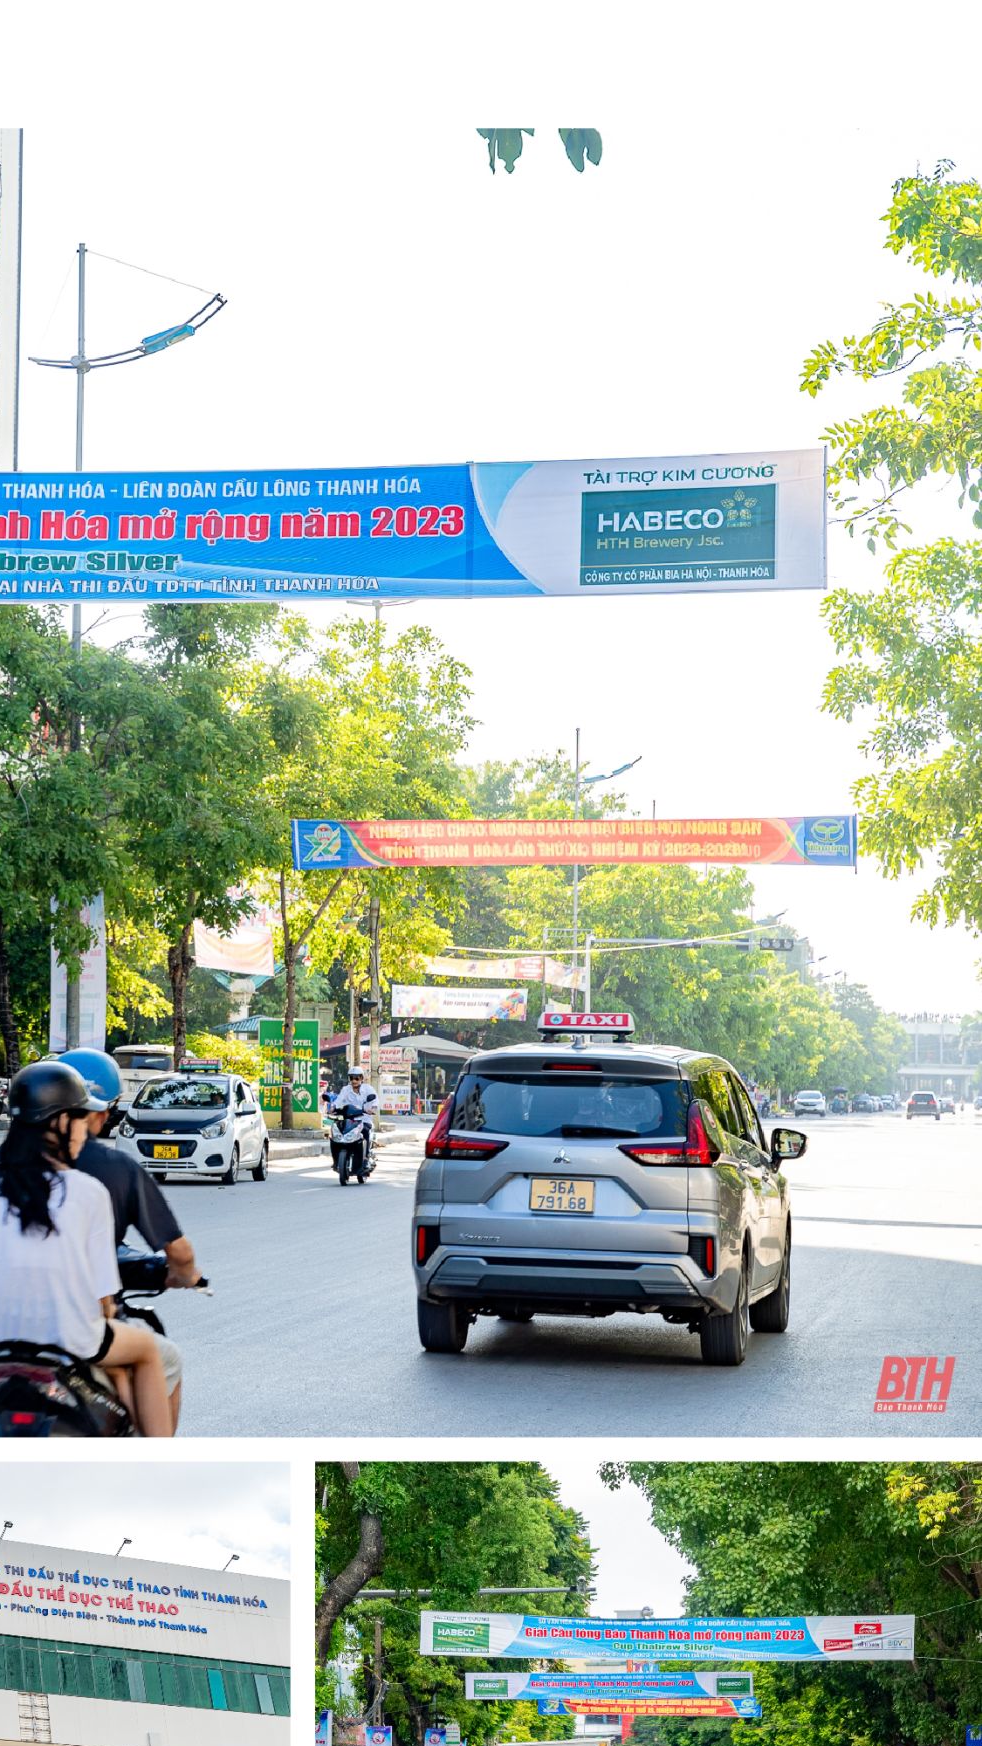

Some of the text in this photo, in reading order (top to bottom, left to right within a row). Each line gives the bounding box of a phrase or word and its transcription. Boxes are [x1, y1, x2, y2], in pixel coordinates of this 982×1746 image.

[2, 482, 65, 500] THANH
[68, 479, 105, 500] HÓA
[123, 480, 163, 499] LIÊN
[167, 478, 217, 499] ĐOÀN
[222, 476, 259, 498] CẦU
[263, 477, 311, 498] LÔNG
[315, 479, 379, 497] THANH
[384, 478, 422, 495] HÓA
[40, 509, 109, 541] Hóa
[119, 508, 177, 540] mở
[185, 509, 272, 546] rộng
[279, 507, 363, 539] năm
[370, 504, 465, 538] 2023
[598, 508, 724, 533] HABECO
[84, 552, 180, 573] Silver
[23, 576, 65, 594] NHÀ
[68, 578, 103, 594] THI
[107, 575, 147, 594] ĐẤU
[153, 578, 206, 594] TDTT
[209, 573, 257, 593] TỈNH
[262, 578, 333, 593] THANH
[337, 575, 380, 592] HÓA
[567, 1015, 623, 1026] TAXI
[549, 1181, 575, 1194] 36A
[537, 1196, 586, 1210] 791.68
[4, 1565, 24, 1577] THI
[28, 1564, 55, 1582] ĐẤU
[58, 1569, 81, 1584] THỂ
[83, 1575, 109, 1589] DỤC
[112, 1576, 134, 1591] THỂ
[137, 1582, 171, 1596] THAO
[174, 1585, 199, 1601] TỈNH
[202, 1592, 240, 1606] THANH
[243, 1591, 267, 1609] HÓA
[37, 1586, 65, 1602] THỂ
[69, 1593, 103, 1608] DỤC
[107, 1594, 134, 1611] THỂ
[137, 1601, 179, 1616] THAO
[437, 1628, 475, 1637] HABECO
